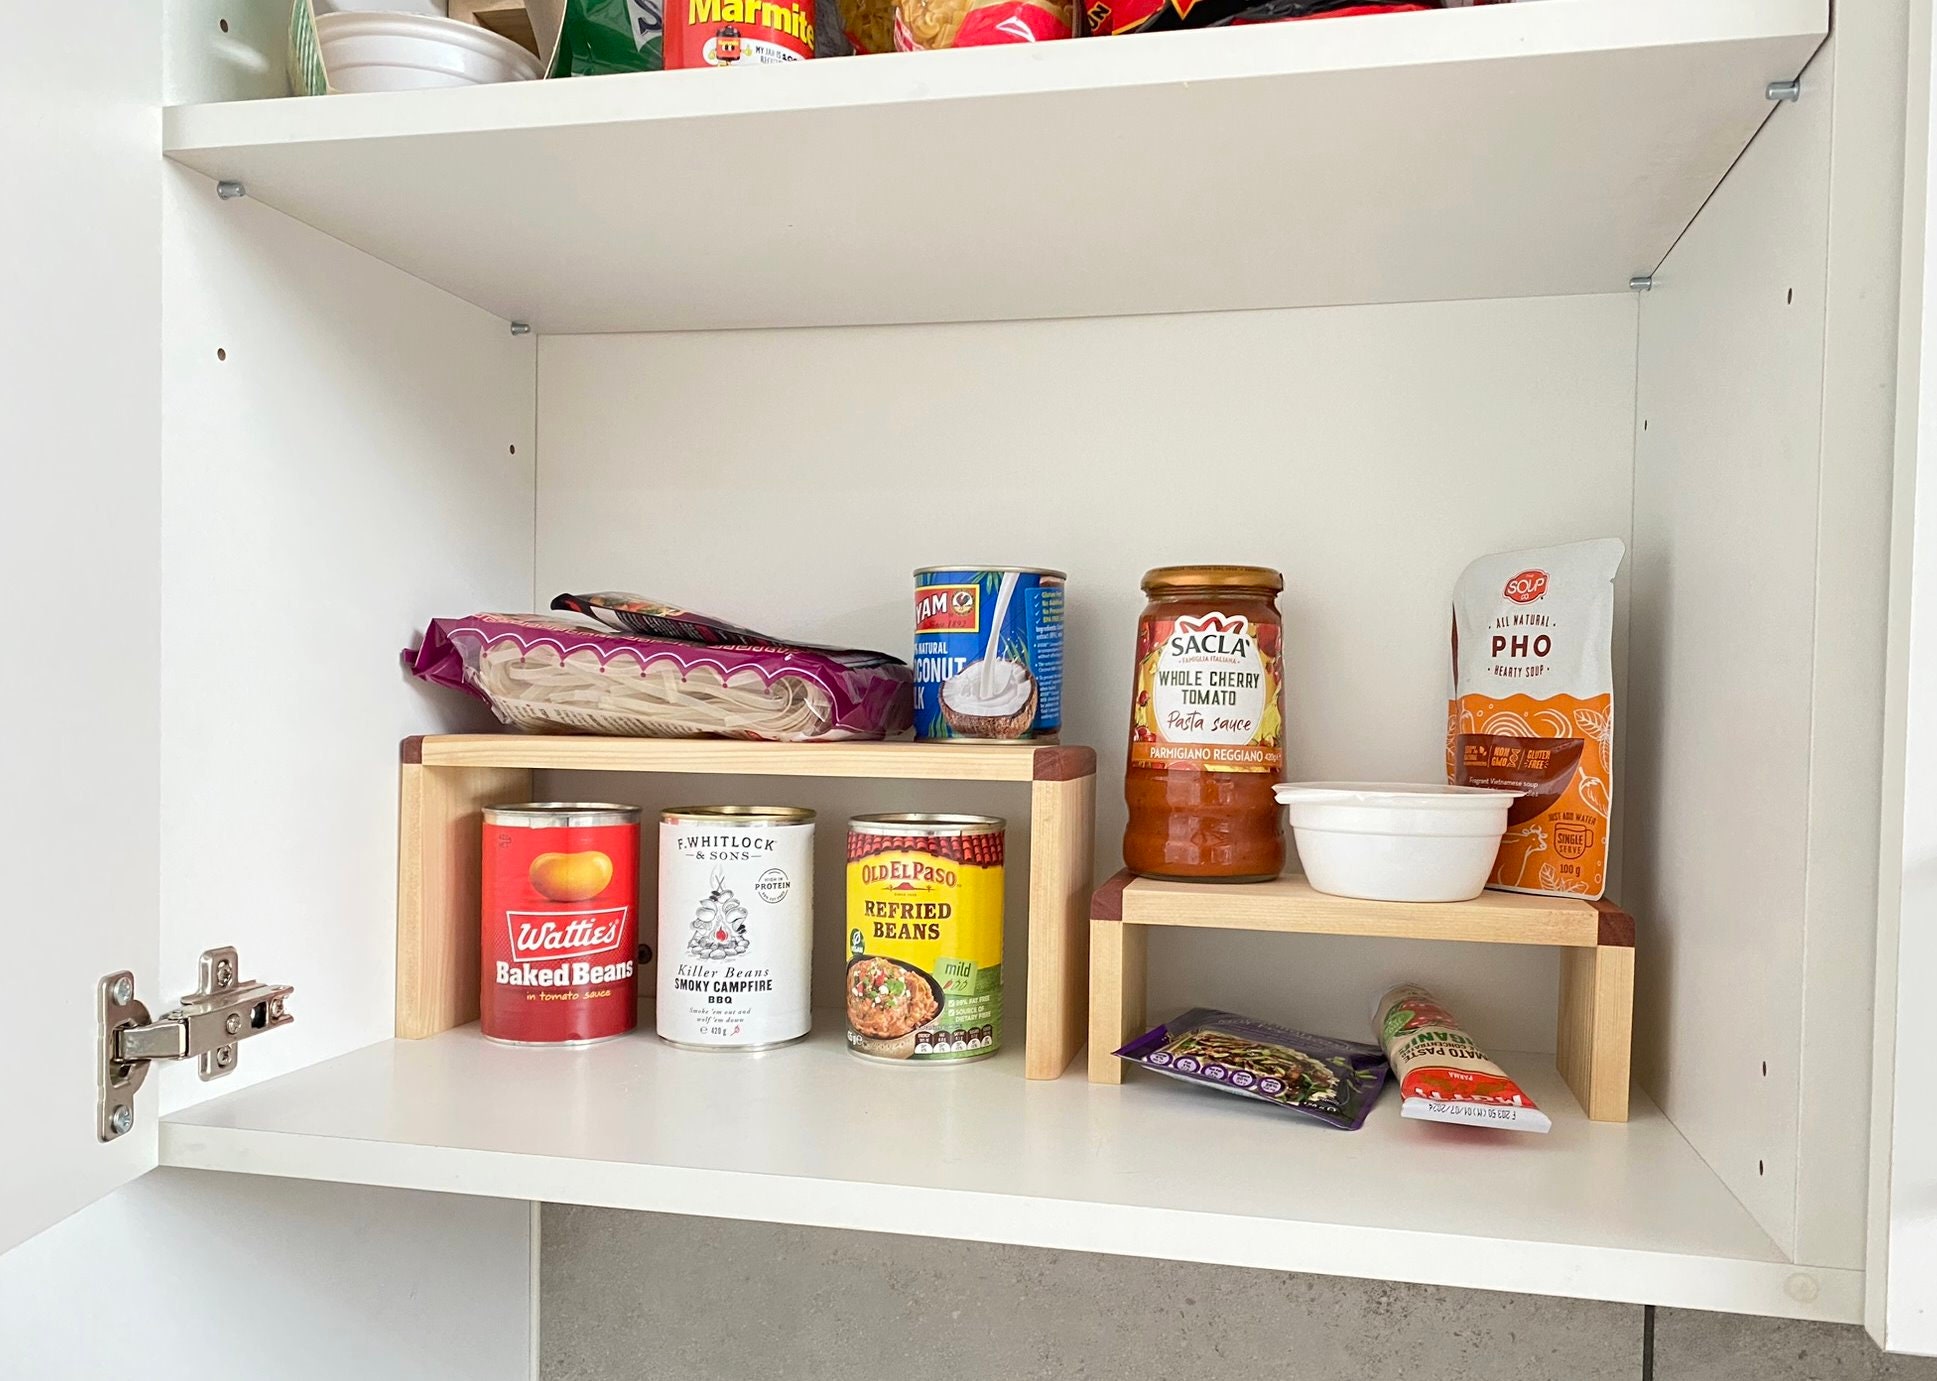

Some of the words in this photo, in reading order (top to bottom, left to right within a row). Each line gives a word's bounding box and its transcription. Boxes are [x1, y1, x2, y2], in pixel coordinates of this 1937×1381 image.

[689, 0, 815, 51] Marmite
[1507, 578, 1544, 594] SOUP
[1497, 616, 1510, 629] ALL
[1514, 614, 1550, 628] NATURAL
[919, 642, 948, 655] NATURAL
[1491, 634, 1552, 658] PHO
[1494, 665, 1522, 678] HEARTY
[1526, 665, 1544, 678] SOUP
[1159, 671, 1203, 686] WHOLE
[1209, 671, 1260, 688] CHERRY
[1182, 689, 1236, 706] TOMATO
[1168, 710, 1204, 732] Pasta
[1211, 718, 1252, 732] sauce
[1150, 747, 1211, 760] PARMIGIANO
[1213, 748, 1263, 763] REGGIANO
[1527, 750, 1551, 760] GLUTEN
[1528, 760, 1544, 769] FREE
[1490, 777, 1522, 787] Vietnamese
[1523, 781, 1538, 789] soup
[1576, 813, 1596, 826] WATER
[1558, 833, 1583, 845] SINGLE
[696, 851, 705, 860] &
[709, 851, 749, 861] SONS
[1559, 845, 1581, 854] SERVE
[862, 864, 889, 885] OLD
[1560, 864, 1574, 874] 100
[1575, 866, 1581, 878] g
[755, 881, 791, 891] PROTEIN
[864, 900, 952, 920] REFRIED
[873, 921, 941, 940] BEANS
[496, 961, 570, 987] Baked
[571, 960, 633, 985] Beans
[678, 964, 718, 978] Killer
[725, 967, 769, 978] Beans
[945, 961, 971, 978] mild
[674, 978, 710, 992] SMOKY
[713, 979, 772, 993] CAMPFIRE
[526, 991, 536, 1000] in
[539, 991, 579, 1001] tomato
[583, 990, 611, 1000] sauce
[708, 995, 732, 1004] BBQ
[956, 1014, 978, 1022] DIETARY
[1405, 1047, 1446, 1064] PASTE
[1448, 1071, 1473, 1081] PARMA
